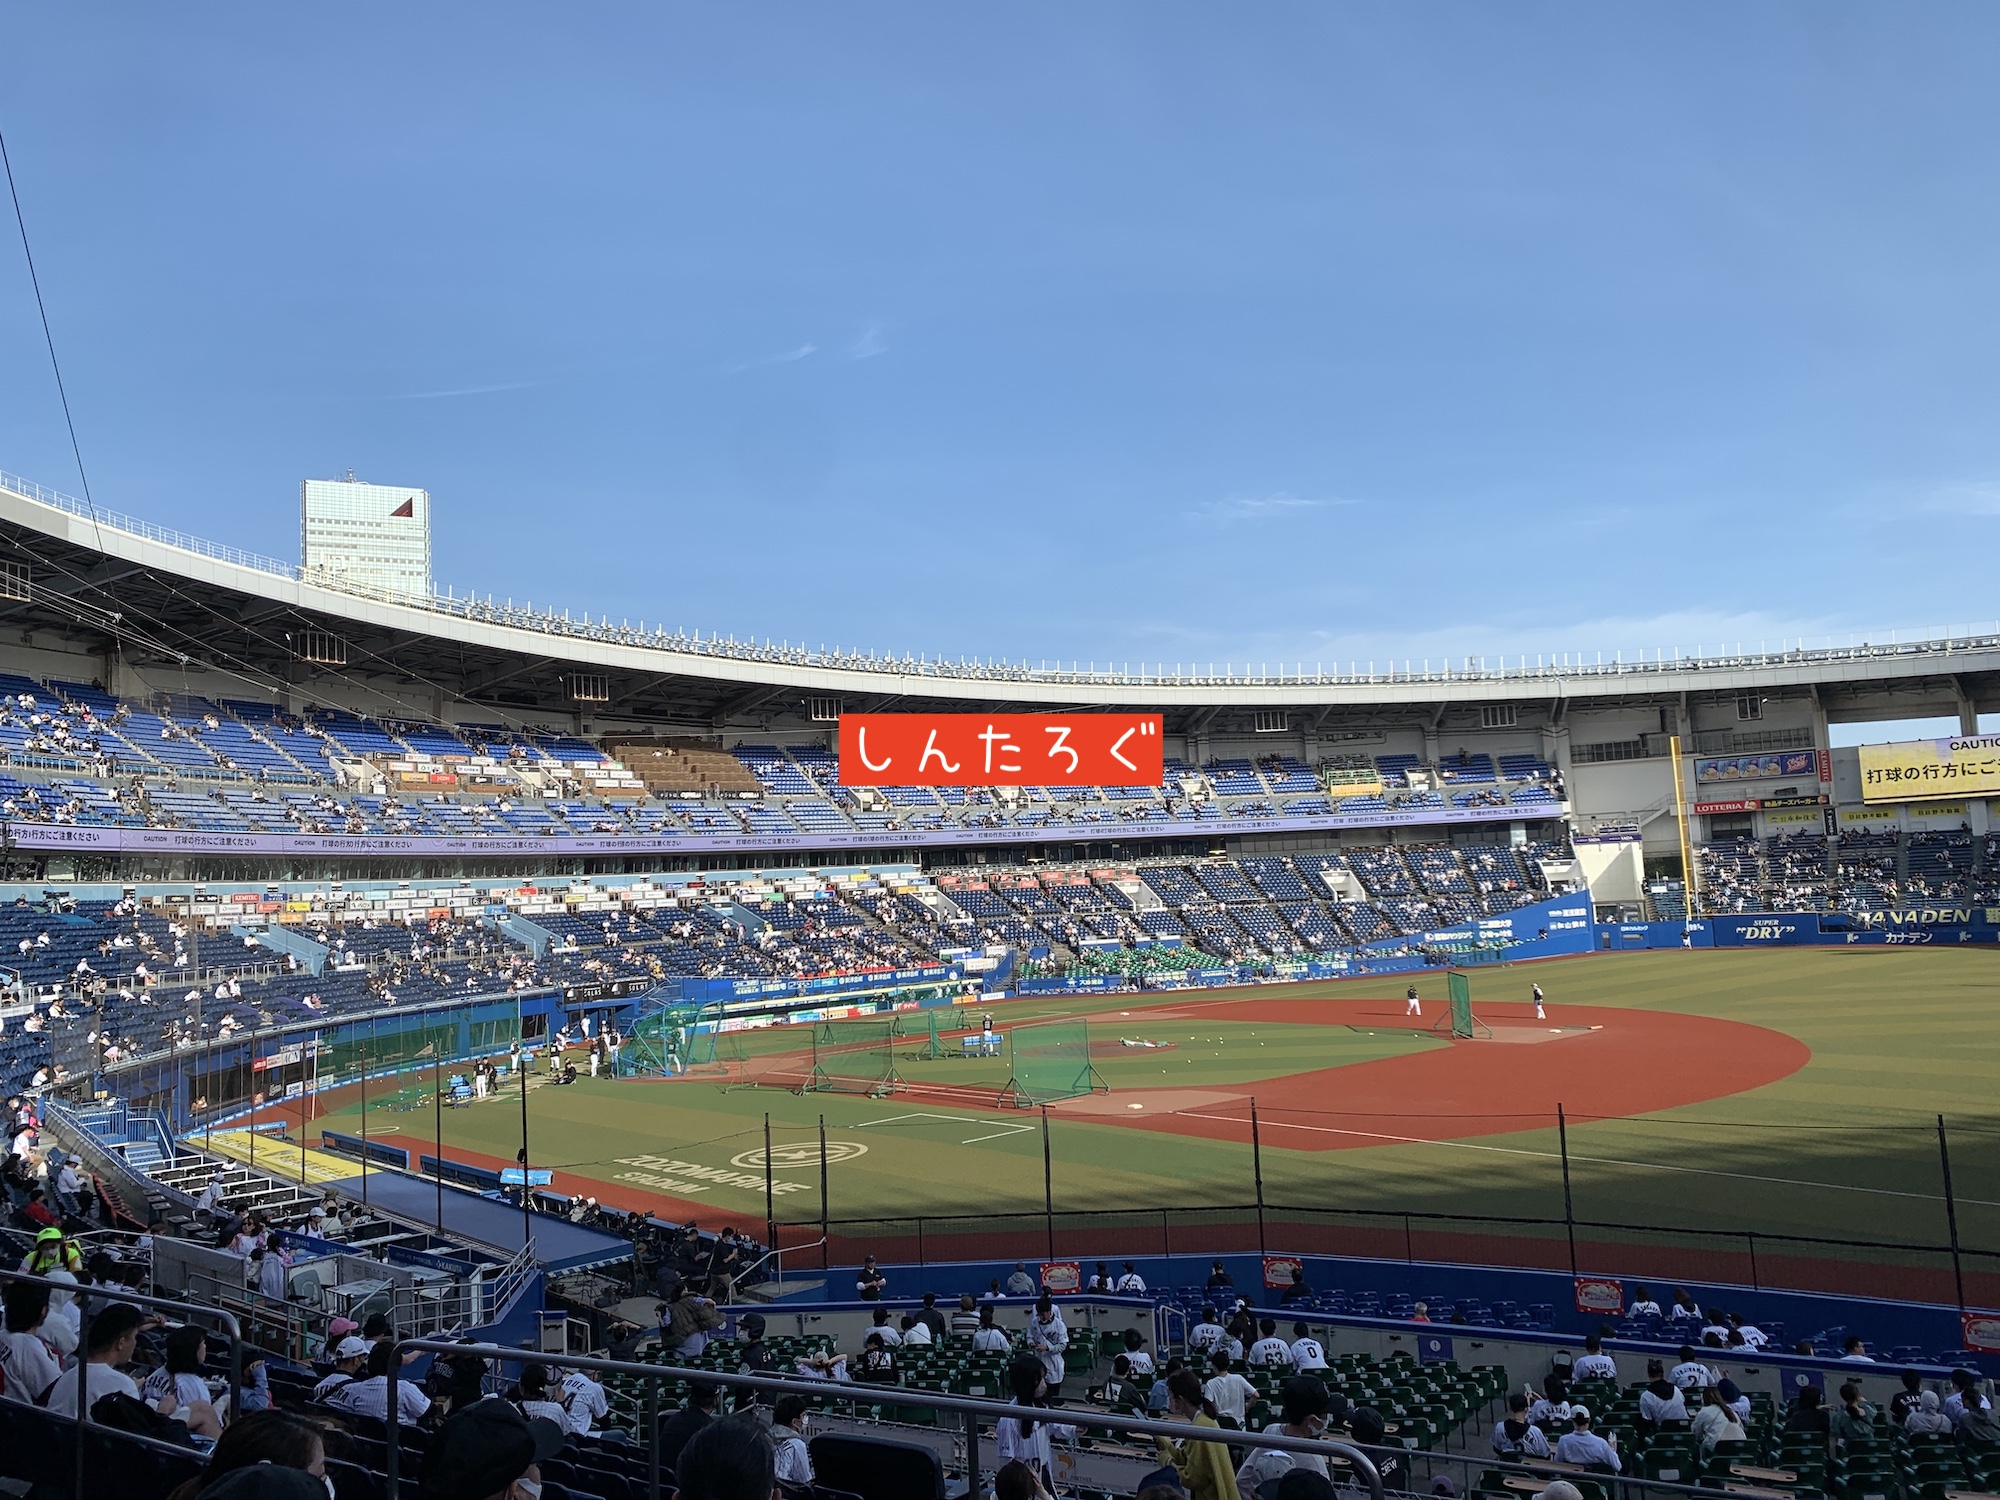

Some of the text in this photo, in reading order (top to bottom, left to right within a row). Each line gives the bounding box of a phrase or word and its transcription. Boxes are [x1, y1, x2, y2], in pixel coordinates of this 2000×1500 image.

[1866, 758, 2000, 784] 打球の行方にご
[1696, 803, 1742, 813] LOTTERIA
[143, 835, 257, 846] CAUTION 打球の行方にご注意ください
[613, 1172, 710, 1195] STADIUM
